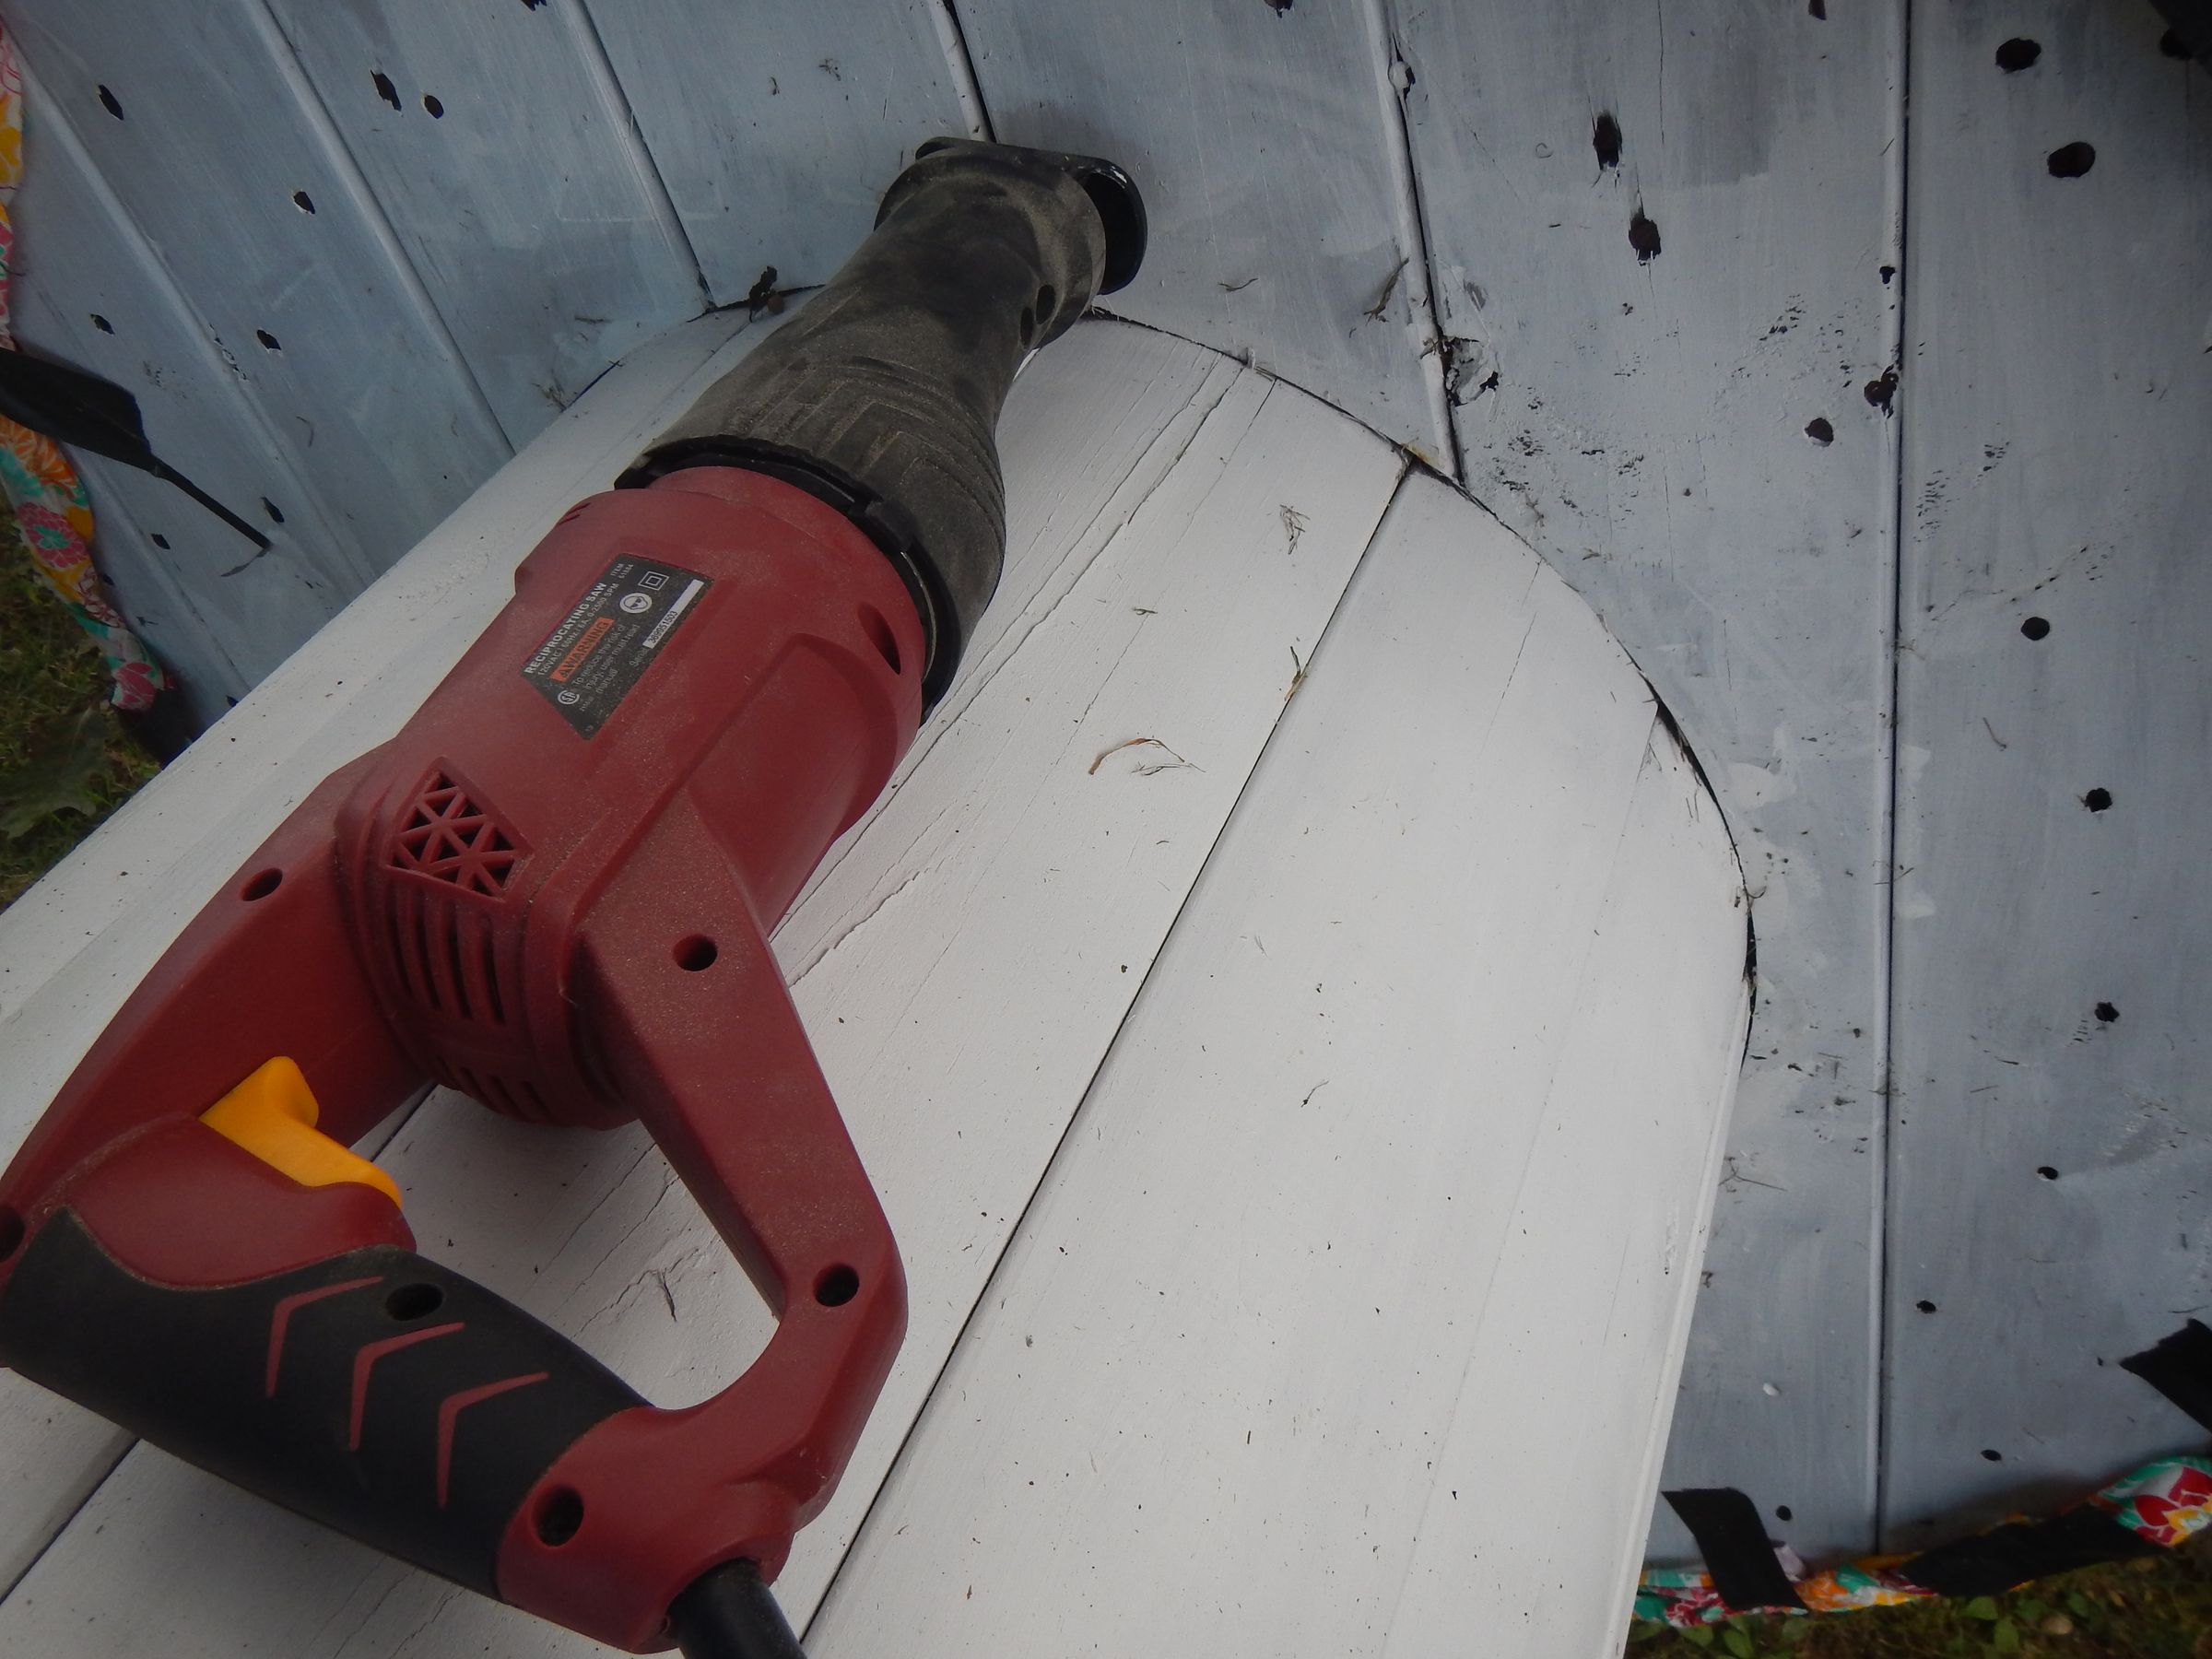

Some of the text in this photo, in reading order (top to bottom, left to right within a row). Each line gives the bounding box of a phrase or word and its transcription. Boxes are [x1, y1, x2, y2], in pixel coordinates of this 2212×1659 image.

[603, 582, 619, 596] SPM
[524, 582, 606, 674] RECIPROCATING SAW
[563, 620, 608, 673] WARNING
[581, 656, 602, 676] reduce
